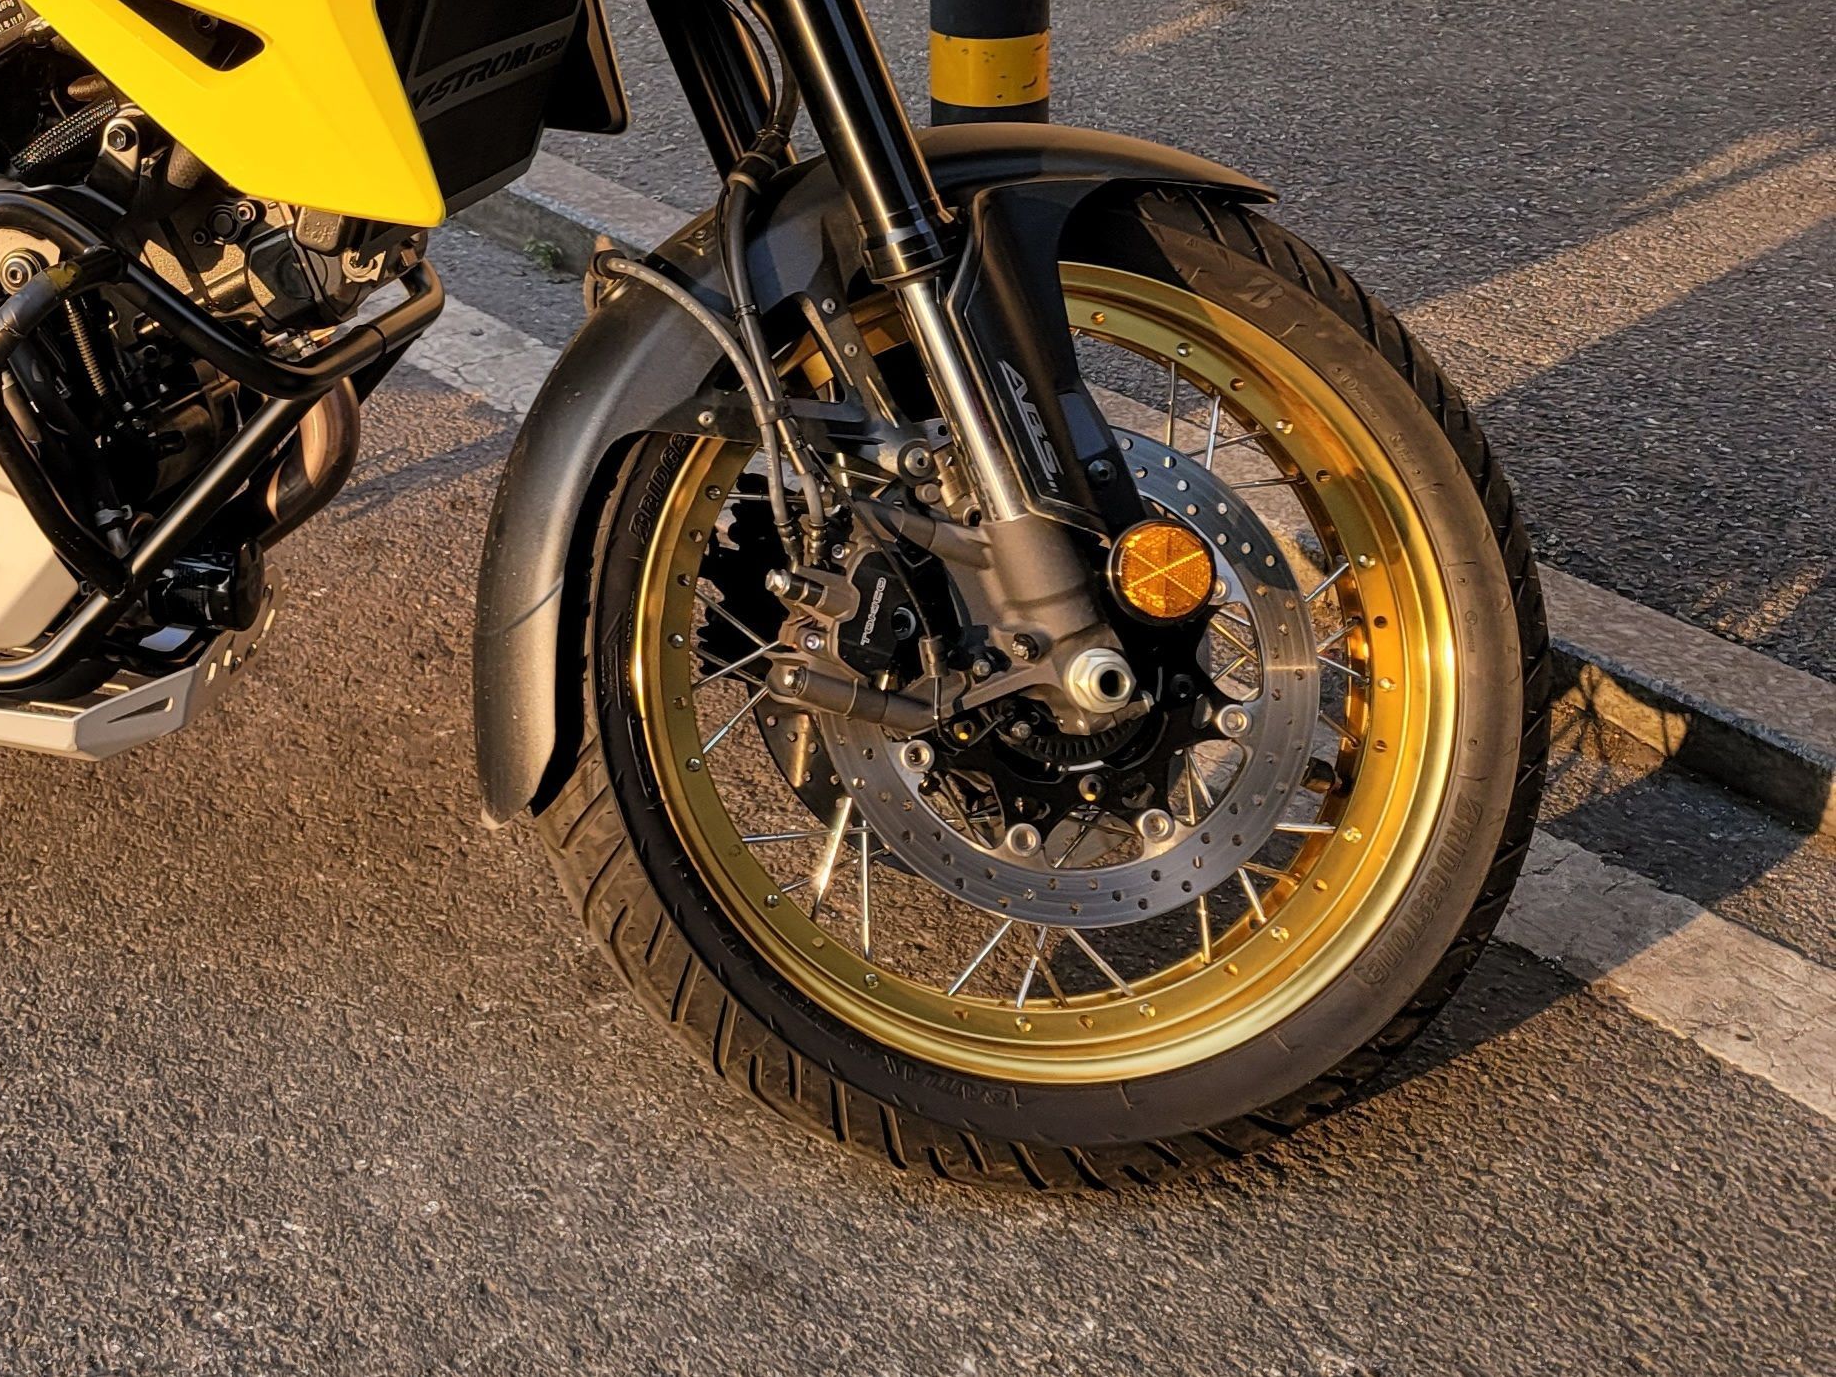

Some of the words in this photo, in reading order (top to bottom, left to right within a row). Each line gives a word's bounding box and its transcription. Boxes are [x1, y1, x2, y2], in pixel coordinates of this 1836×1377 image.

[997, 359, 1064, 482] ABS
[860, 576, 887, 646] TOKICO
[1354, 791, 1483, 985] BRIDGESTONE
